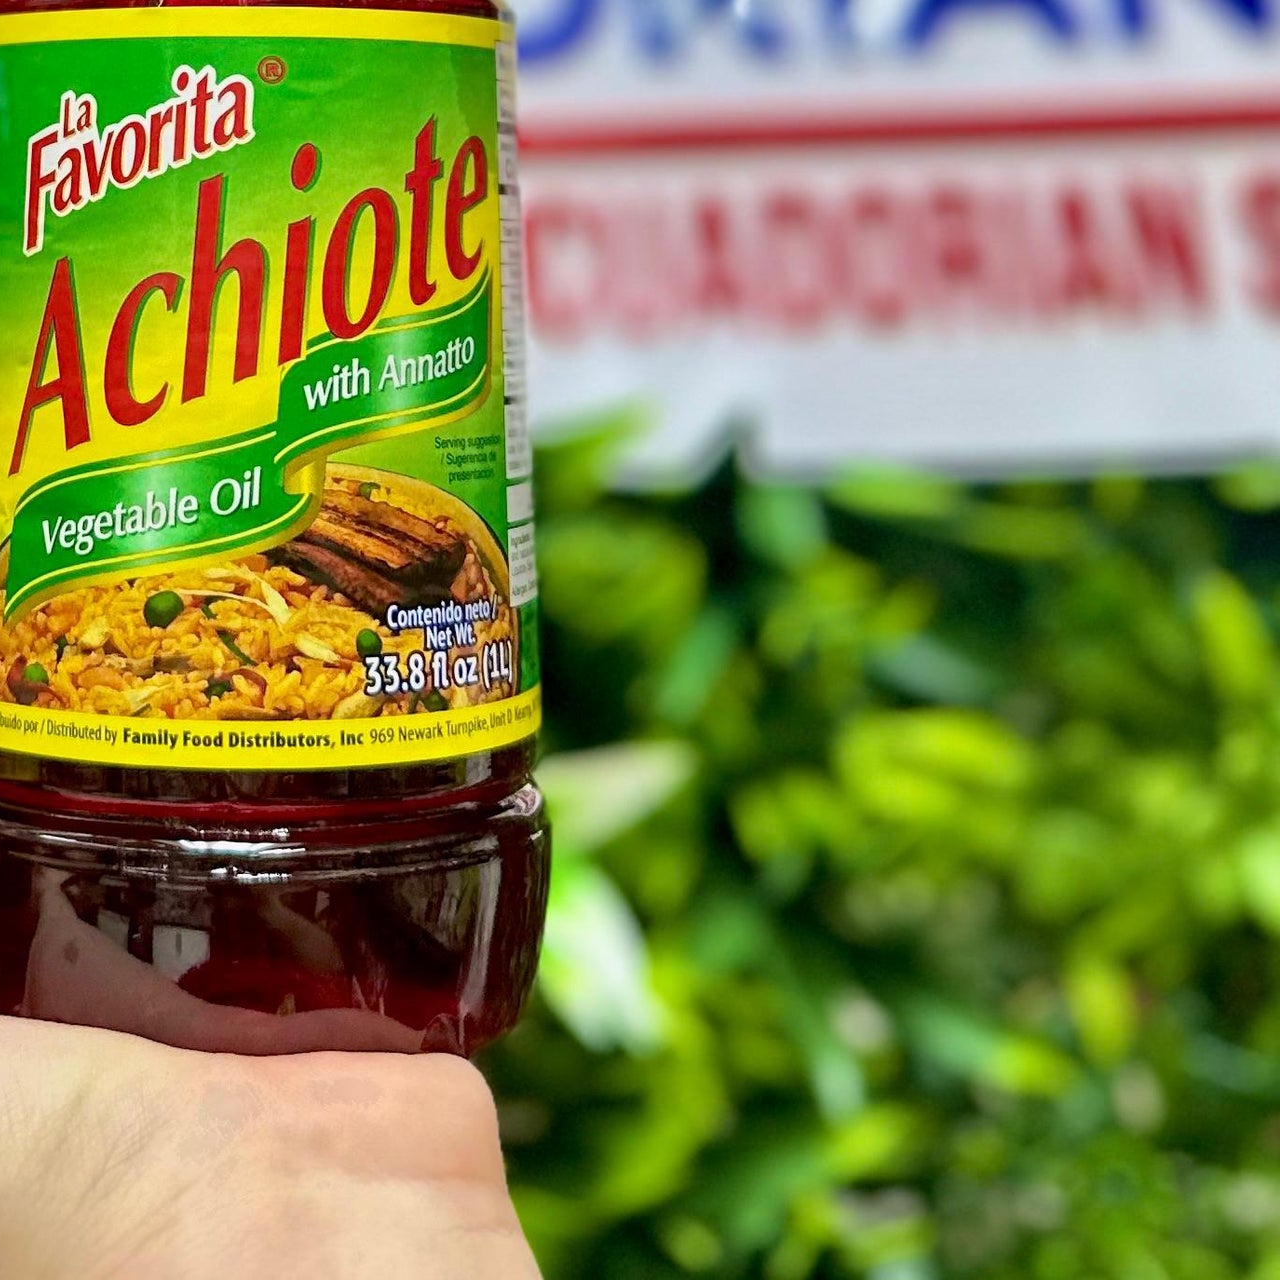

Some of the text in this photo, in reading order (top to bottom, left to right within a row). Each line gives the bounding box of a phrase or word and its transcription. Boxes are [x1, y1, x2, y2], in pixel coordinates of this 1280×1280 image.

[61, 94, 93, 138] La
[24, 69, 251, 253] Favorita
[8, 114, 489, 478] Achiote
[304, 335, 475, 411] with Annatto
[435, 436, 465, 450] Serving
[41, 466, 262, 556] Vegetable Oil
[387, 600, 463, 628] Contenido
[426, 622, 477, 649] Net Wt.
[365, 639, 513, 695] 33.8 fl oz (1L)
[24, 721, 38, 735] por
[47, 721, 102, 741] Distributed
[104, 724, 117, 746] by
[123, 727, 178, 749] Family
[183, 730, 223, 747] Food
[228, 730, 335, 750] Distributors,
[340, 730, 364, 746] Inc
[370, 728, 395, 744] 969
[398, 722, 444, 742] Newark
[446, 718, 489, 737] Turnpike,
[490, 711, 507, 729] Unit
